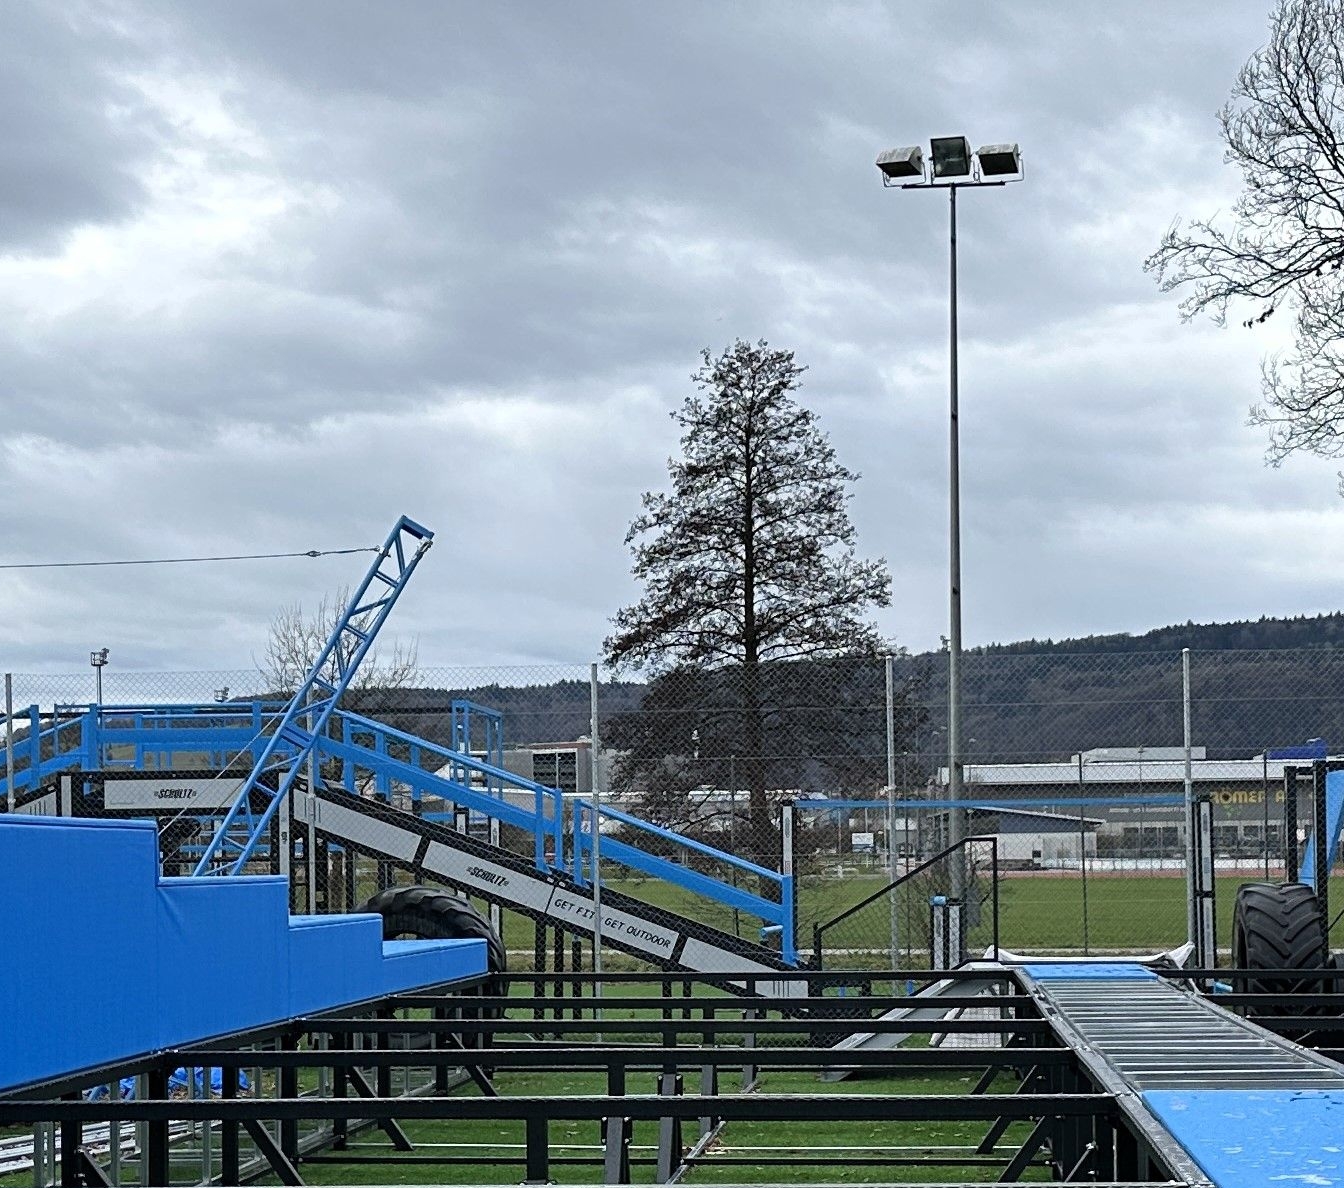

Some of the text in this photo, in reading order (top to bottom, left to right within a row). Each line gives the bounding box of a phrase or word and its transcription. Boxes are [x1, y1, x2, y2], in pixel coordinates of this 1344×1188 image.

[554, 898, 671, 948] GET FIT GET OUTDOOR
